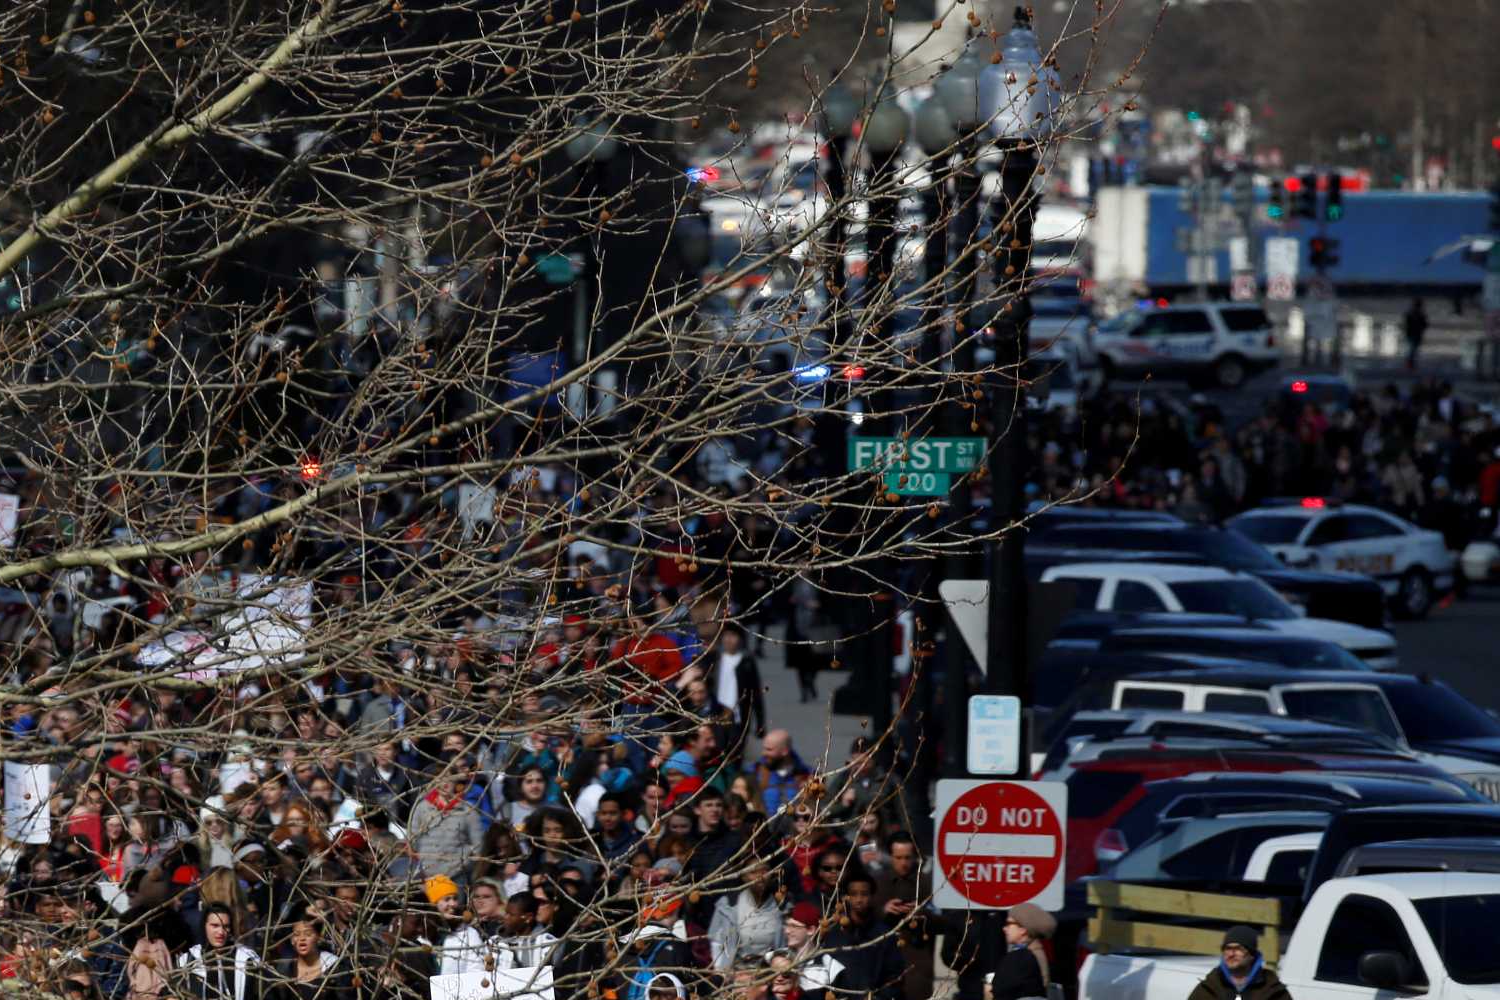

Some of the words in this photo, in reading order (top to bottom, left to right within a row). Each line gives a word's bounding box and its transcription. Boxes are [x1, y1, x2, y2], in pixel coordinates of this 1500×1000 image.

[854, 441, 953, 470] FIRST
[956, 442, 976, 455] ST
[956, 806, 988, 826] DO
[1001, 808, 1047, 828] NOT
[962, 863, 1035, 883] ENTER
